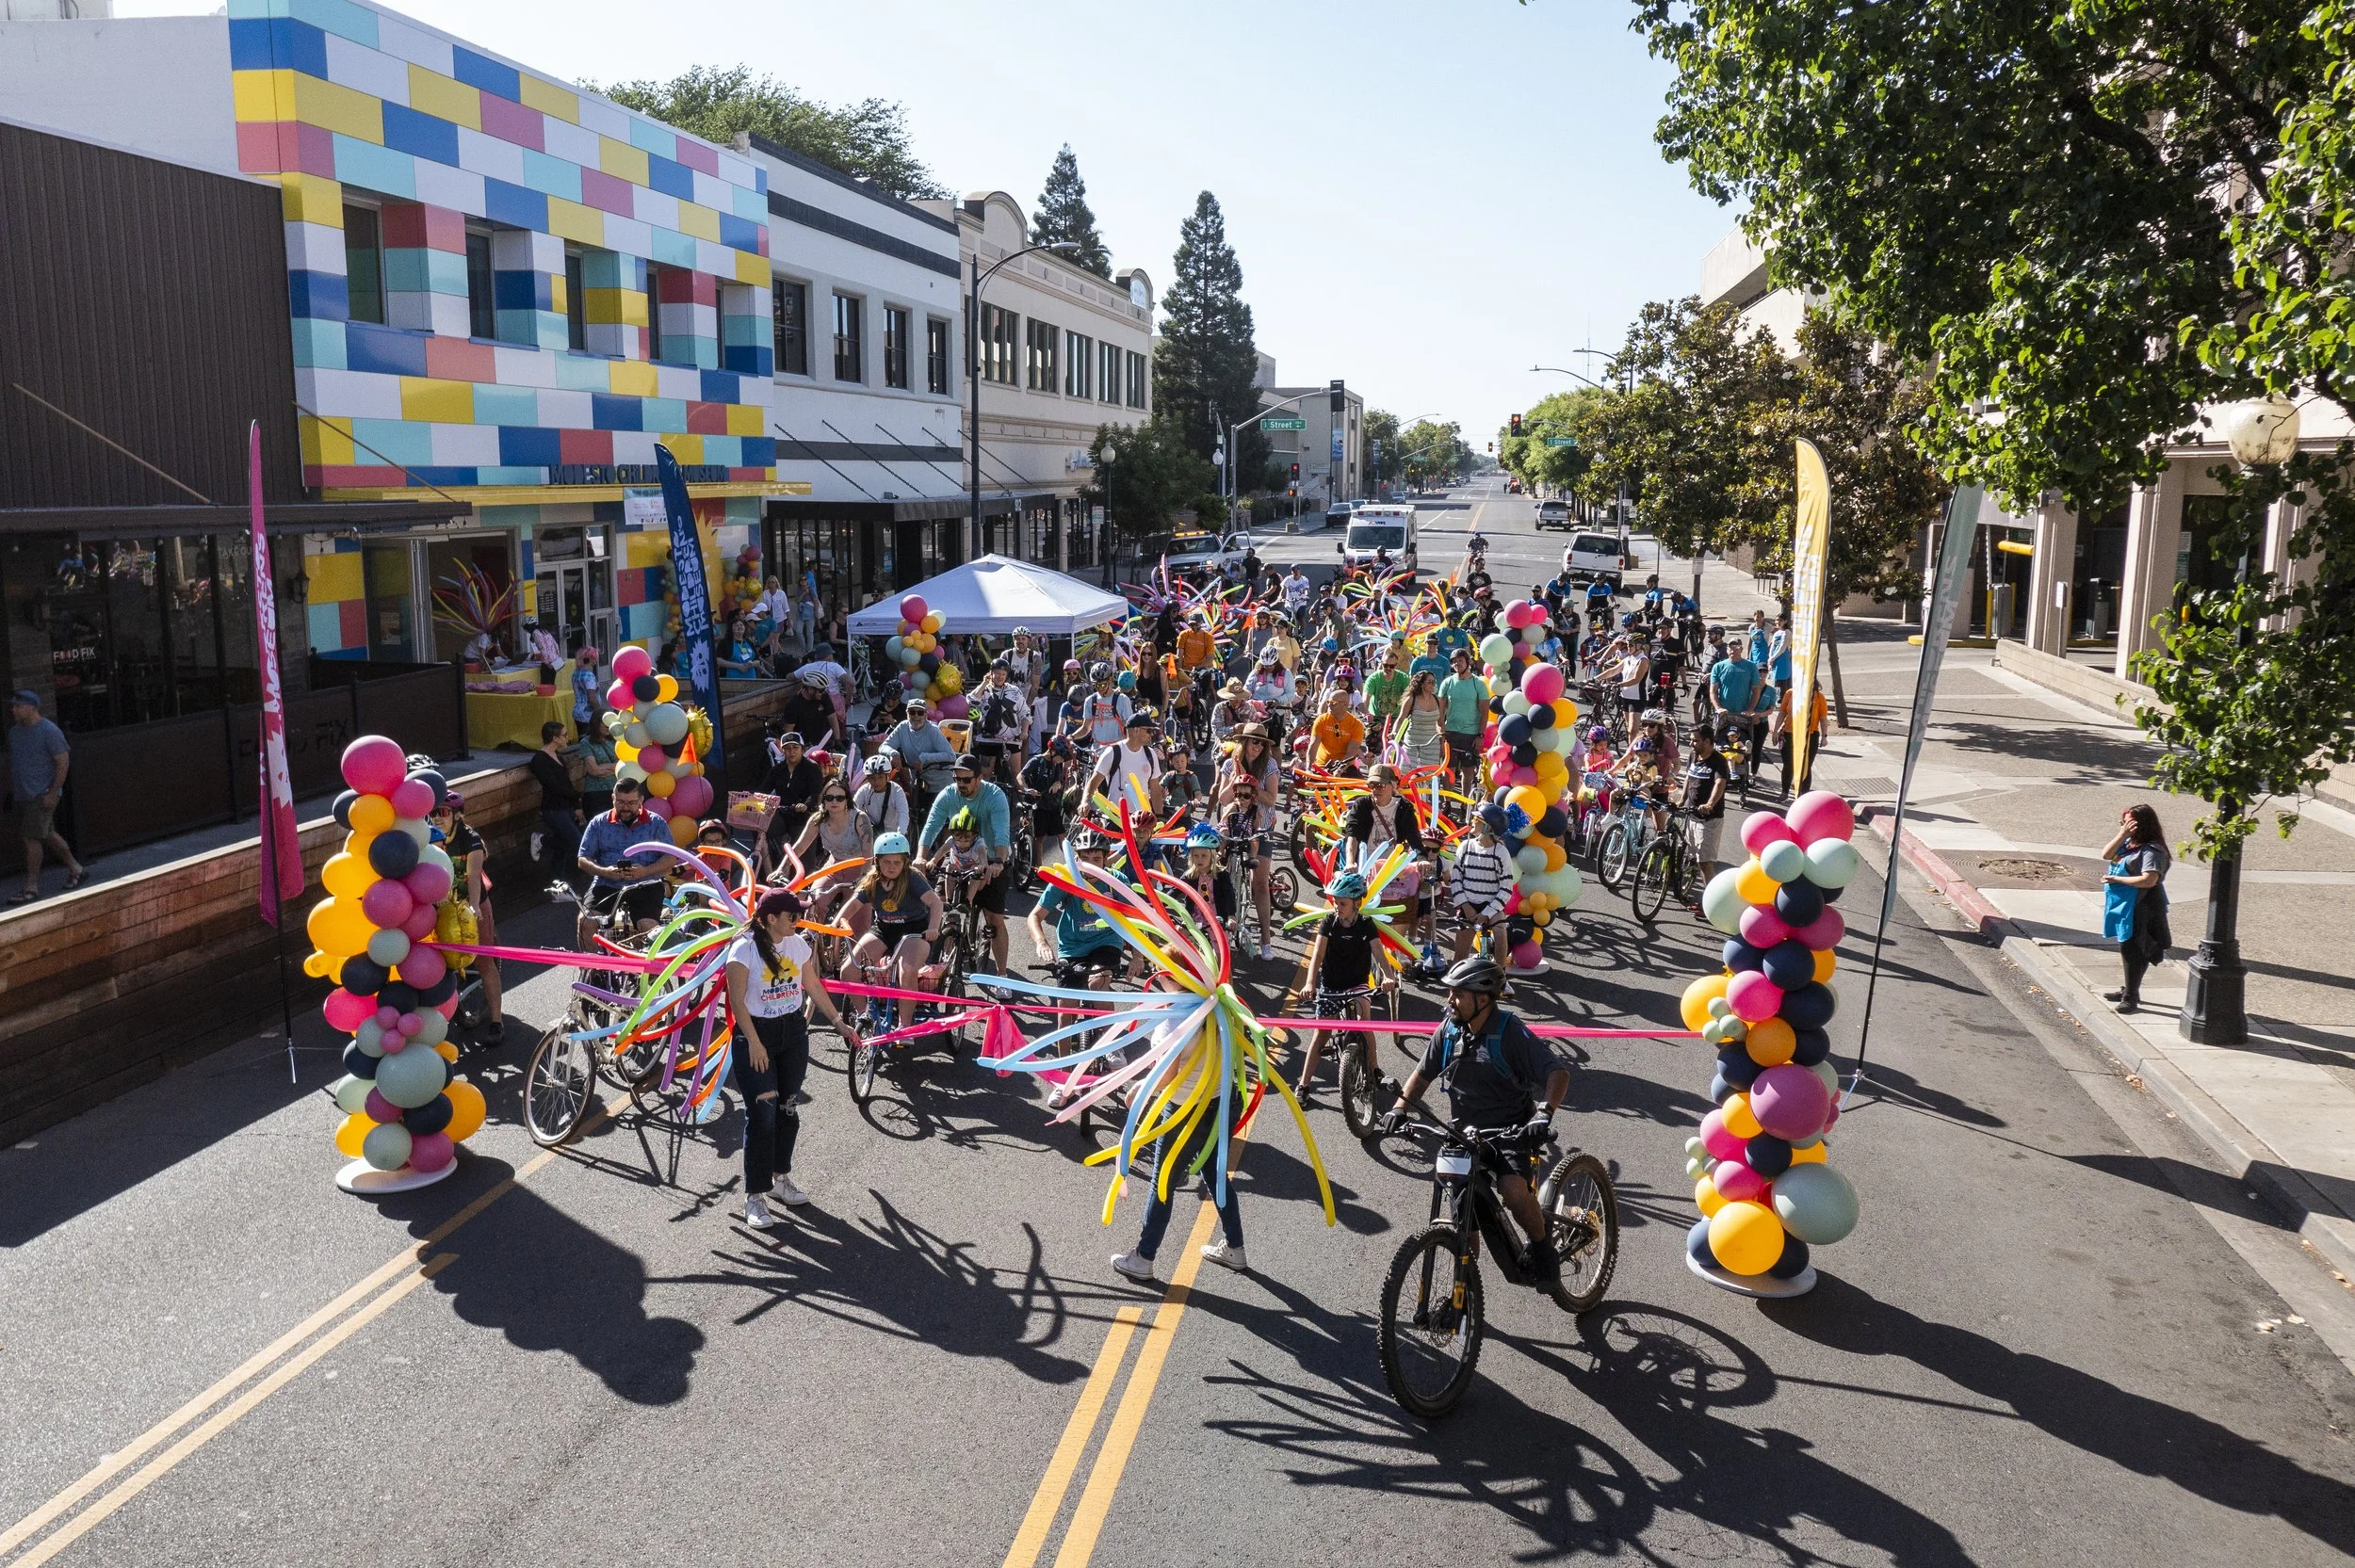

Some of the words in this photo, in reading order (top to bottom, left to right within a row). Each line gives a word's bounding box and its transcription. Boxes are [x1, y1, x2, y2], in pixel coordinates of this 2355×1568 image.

[549, 464, 615, 485] MODESTO
[683, 464, 726, 483] MUSEUM
[688, 537, 708, 633] MUSEUM
[81, 646, 95, 657] FIX
[763, 983, 798, 994] MODESTO
